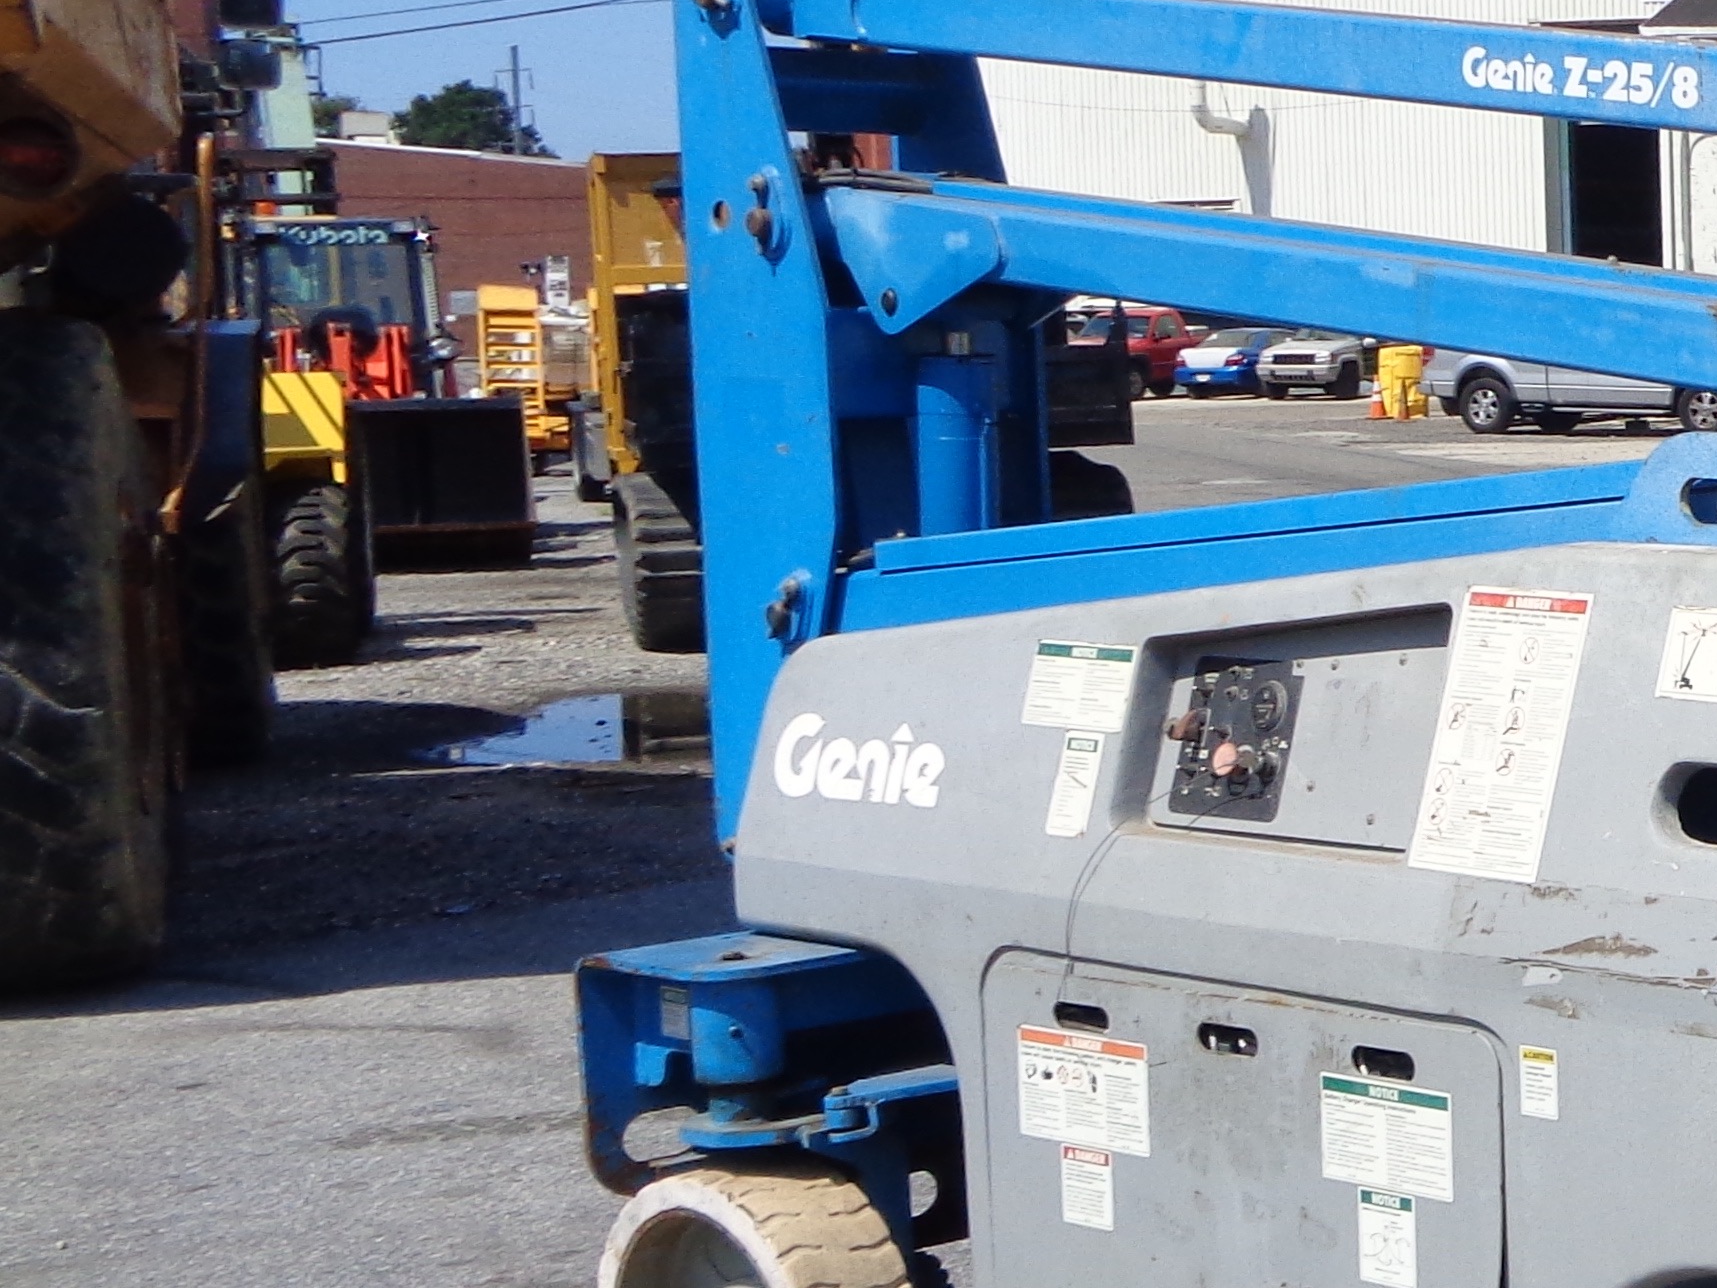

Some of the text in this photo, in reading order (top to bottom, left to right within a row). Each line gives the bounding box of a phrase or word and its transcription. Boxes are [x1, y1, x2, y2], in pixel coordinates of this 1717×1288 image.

[1462, 46, 1699, 109] Genie Z-25/8
[774, 712, 946, 808] Genie
[1368, 1085, 1400, 1101] NOTICE
[1371, 1192, 1401, 1209] NOTICE
